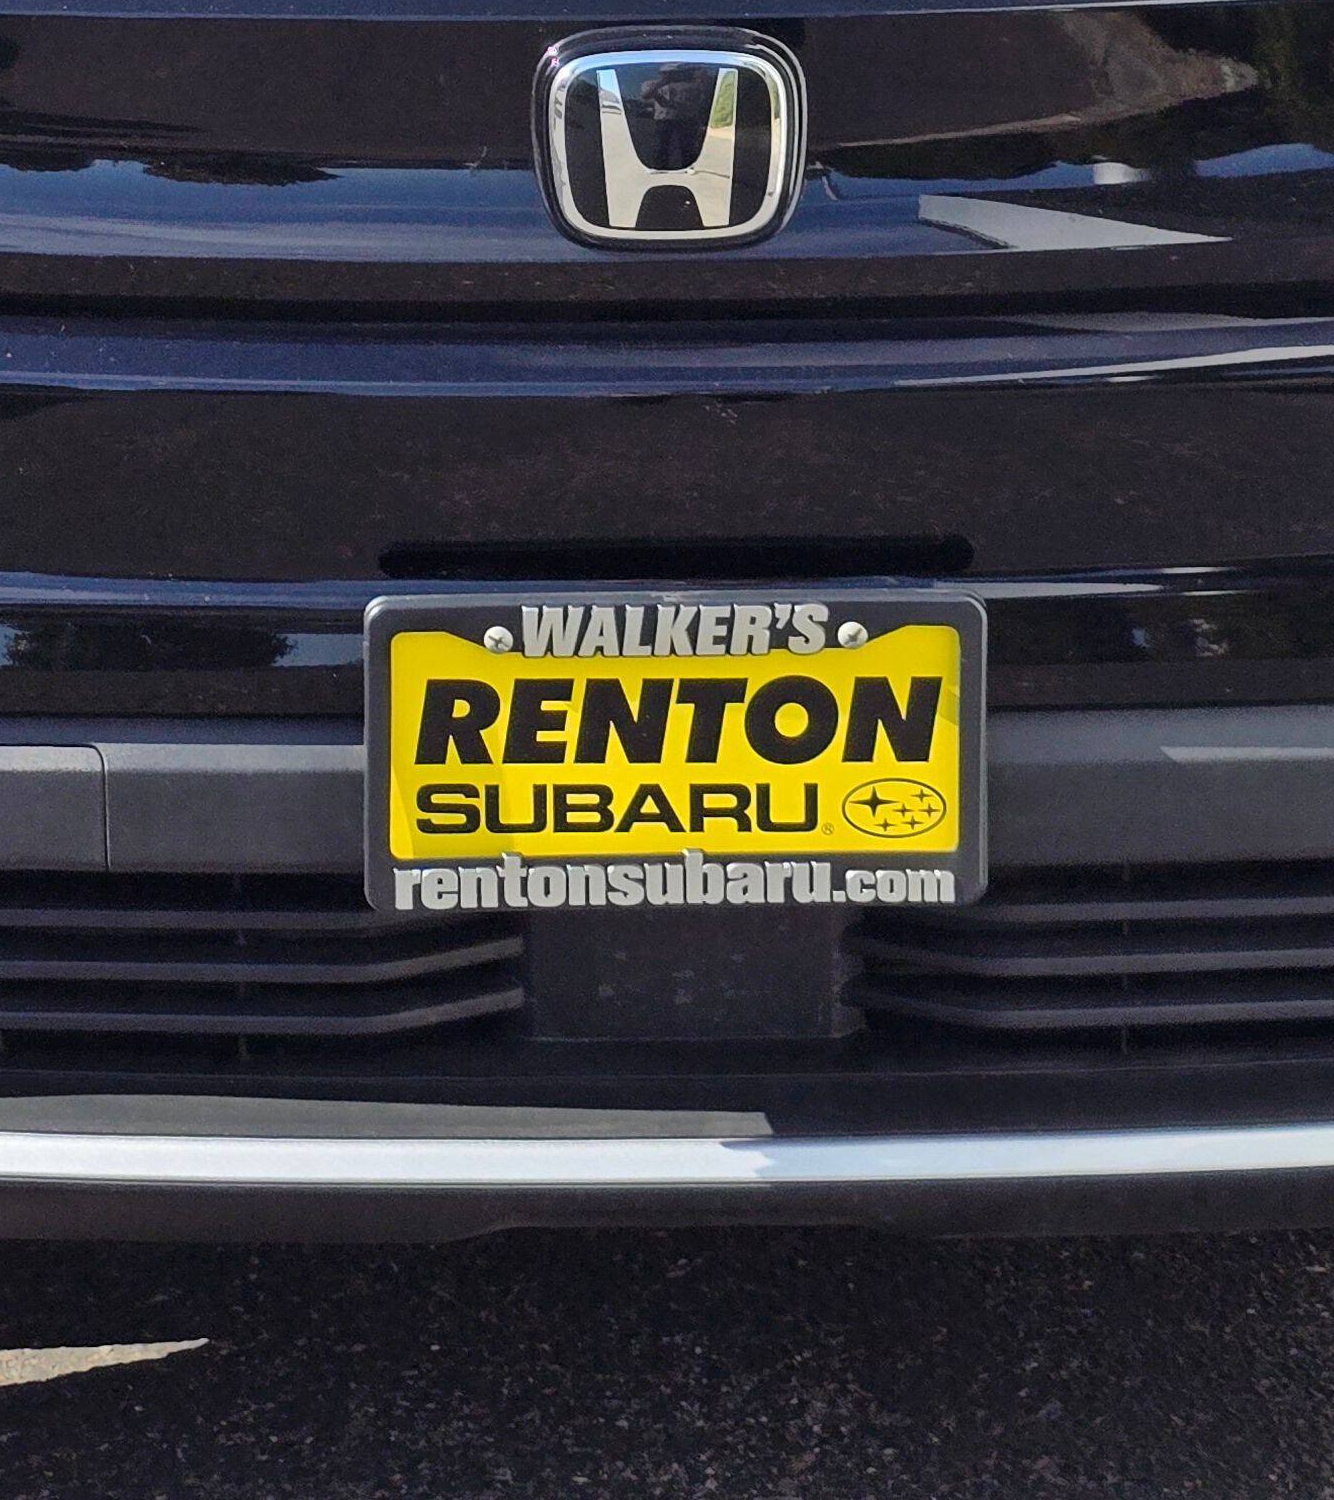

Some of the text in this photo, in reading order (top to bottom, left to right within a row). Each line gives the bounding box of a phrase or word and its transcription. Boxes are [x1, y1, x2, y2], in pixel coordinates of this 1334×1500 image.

[521, 602, 829, 658] WALKER'S
[414, 675, 943, 765] RENTON
[415, 782, 818, 835] SUBARU
[393, 848, 955, 910] rentonsubaru.com
